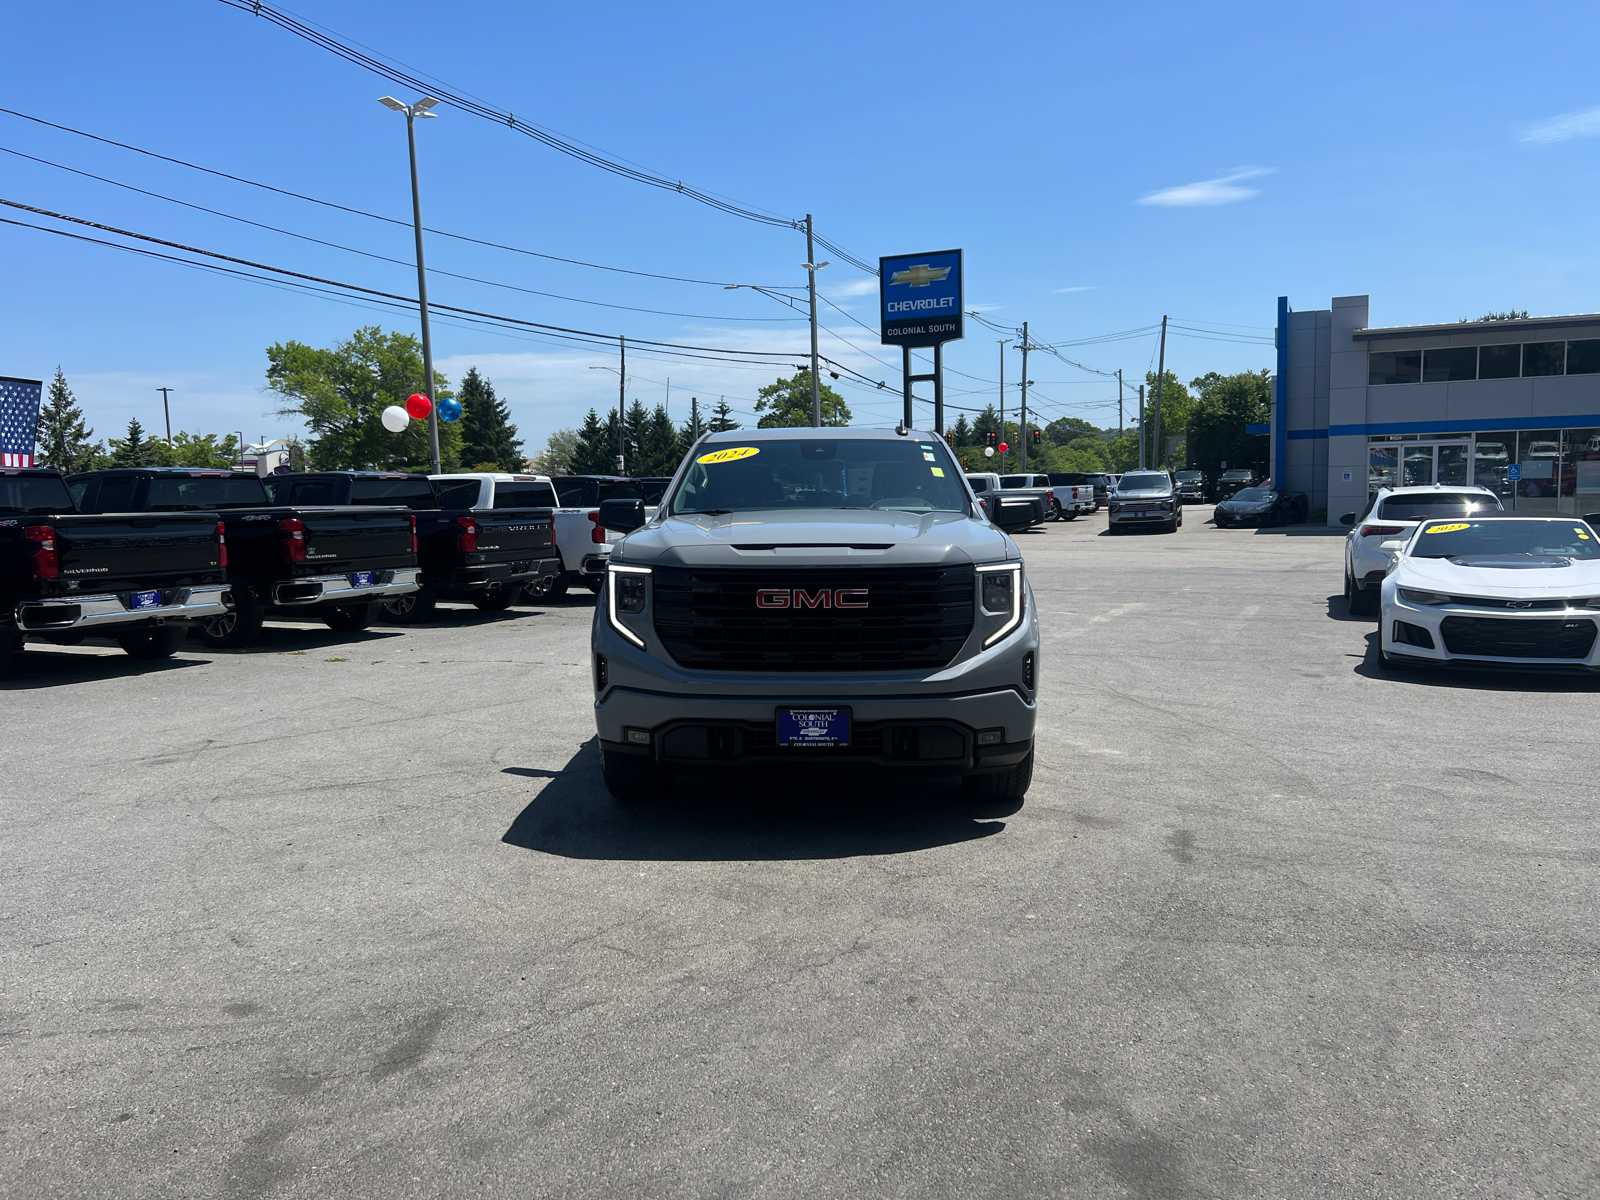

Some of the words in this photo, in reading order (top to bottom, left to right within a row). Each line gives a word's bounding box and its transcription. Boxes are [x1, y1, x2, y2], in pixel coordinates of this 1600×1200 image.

[887, 296, 955, 313] CHEVROLET
[887, 326, 926, 336] COLONIAL
[928, 323, 956, 333] SOUTH
[706, 449, 749, 462] 2024
[1434, 523, 1463, 533] 2023
[755, 588, 869, 609] GMC
[798, 720, 828, 728] SOUTH
